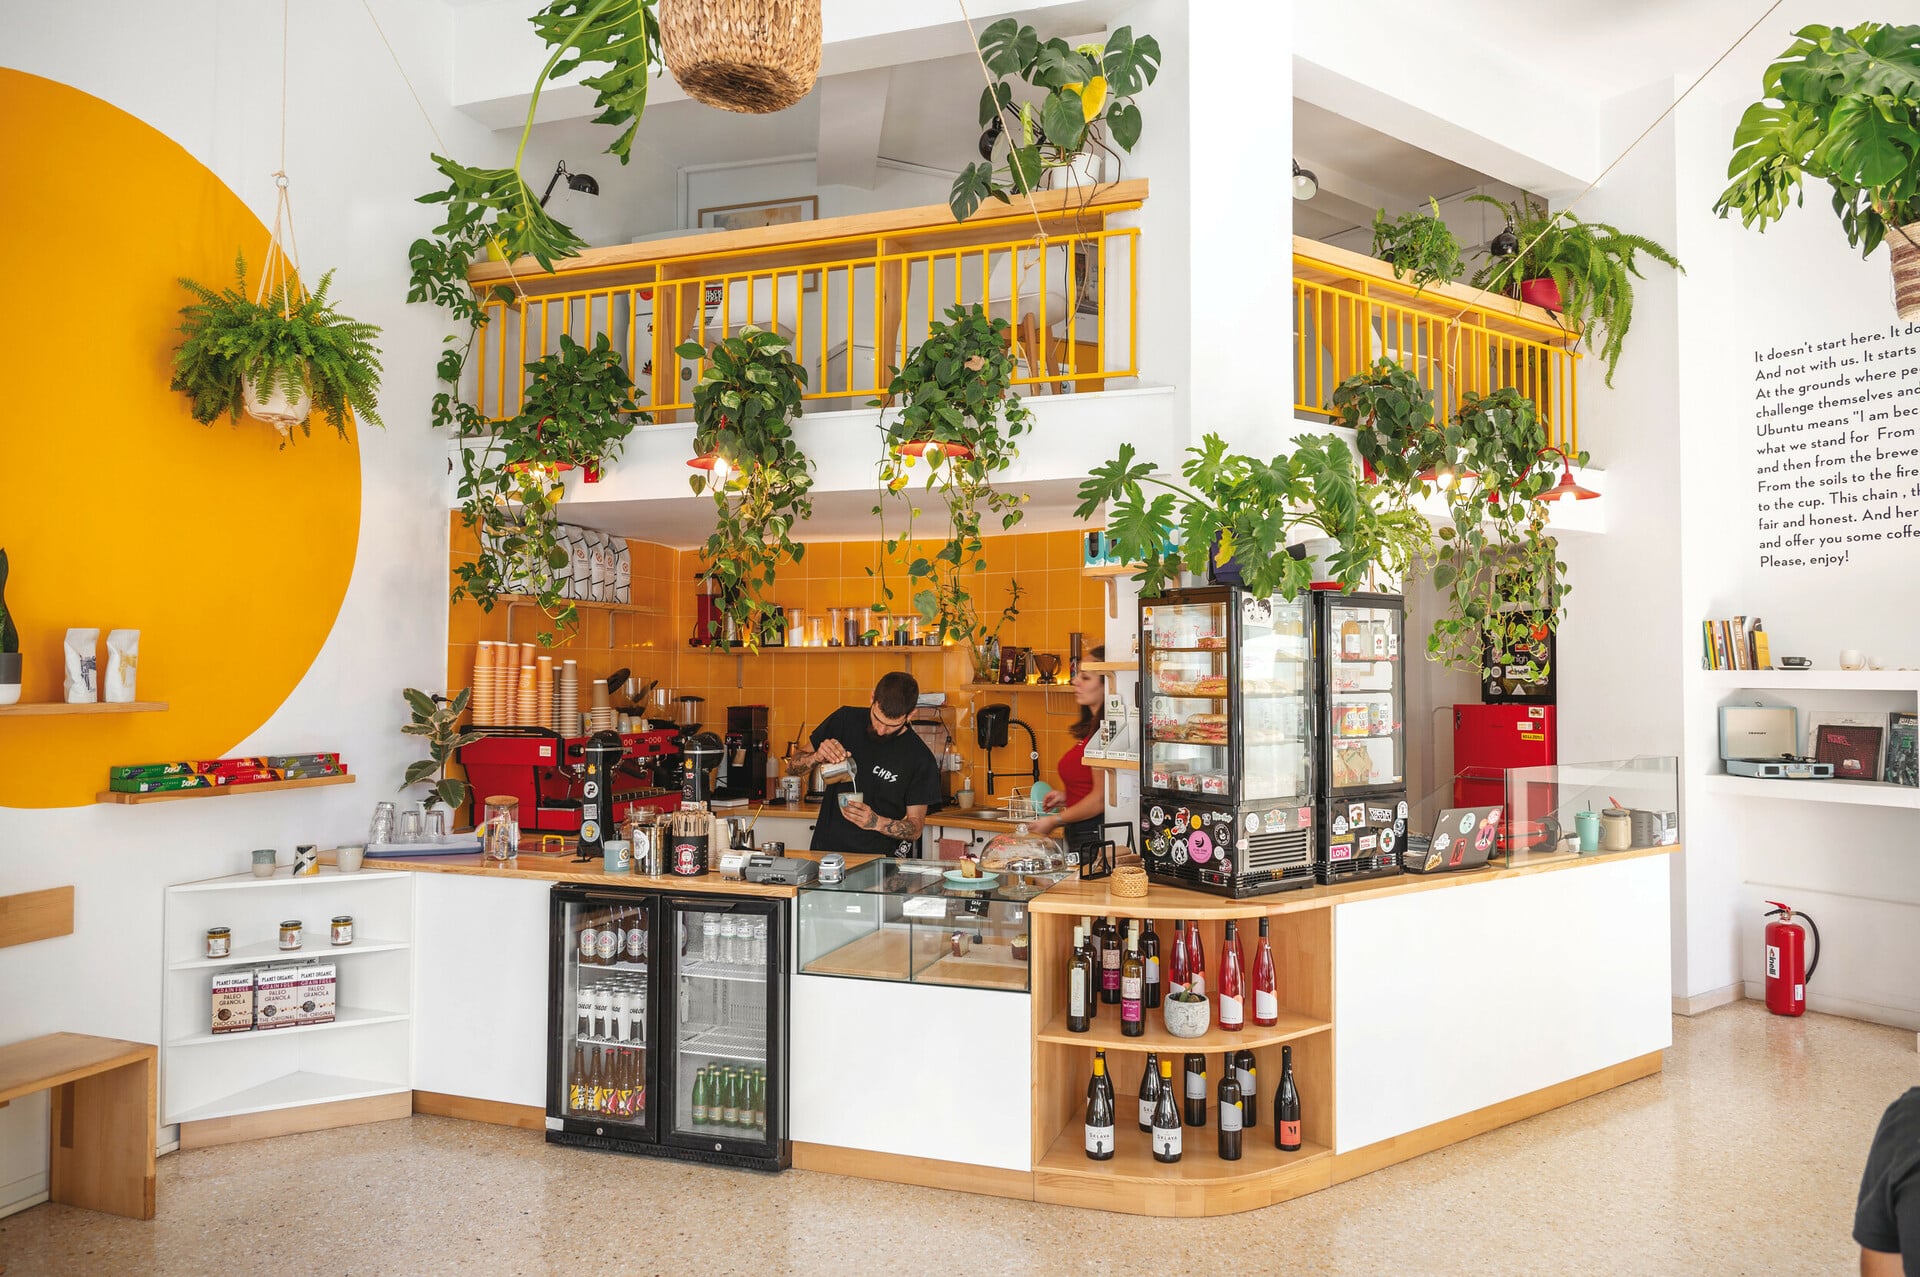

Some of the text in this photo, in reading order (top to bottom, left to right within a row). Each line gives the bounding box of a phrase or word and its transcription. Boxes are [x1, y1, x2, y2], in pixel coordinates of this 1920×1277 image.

[1755, 351, 1763, 362] It
[1767, 342, 1812, 360] doesn't
[1817, 338, 1846, 351] start
[1851, 332, 1885, 345] here.
[1891, 325, 1900, 338] It
[1755, 346, 1916, 381] And not with us. It starts
[1756, 367, 1920, 399] At the grounds where pe
[1756, 403, 1814, 418] challenge
[1818, 389, 1893, 409] themselves
[1757, 423, 1803, 436] Ubuntu
[1808, 418, 1849, 429] means
[1869, 412, 1889, 421] am
[1757, 442, 1785, 454] what
[1811, 432, 1845, 448] stand
[1878, 426, 1915, 440] From
[1757, 460, 1779, 474] and
[1783, 458, 1811, 471] then
[1815, 454, 1845, 467] from
[1850, 450, 1871, 463] the
[1758, 480, 1791, 492] From
[1795, 476, 1815, 489] the
[1820, 471, 1848, 486] soils
[1852, 474, 1865, 483] to
[1870, 467, 1892, 481] the
[1774, 497, 1794, 510] the
[1798, 499, 1824, 509] cup.
[1829, 491, 1858, 504] This
[1862, 488, 1898, 501] chain
[1759, 518, 1779, 530] fair
[1783, 514, 1805, 528] and
[1809, 513, 1857, 525] honest.
[1862, 506, 1891, 521] And
[1759, 535, 1781, 549] and
[1785, 533, 1815, 547] offer
[1819, 536, 1842, 548] you
[1847, 533, 1882, 542] some
[1760, 550, 1849, 567] Please, enjoy!
[872, 765, 899, 783] CHBS
[264, 994, 291, 1002] GRANOLA
